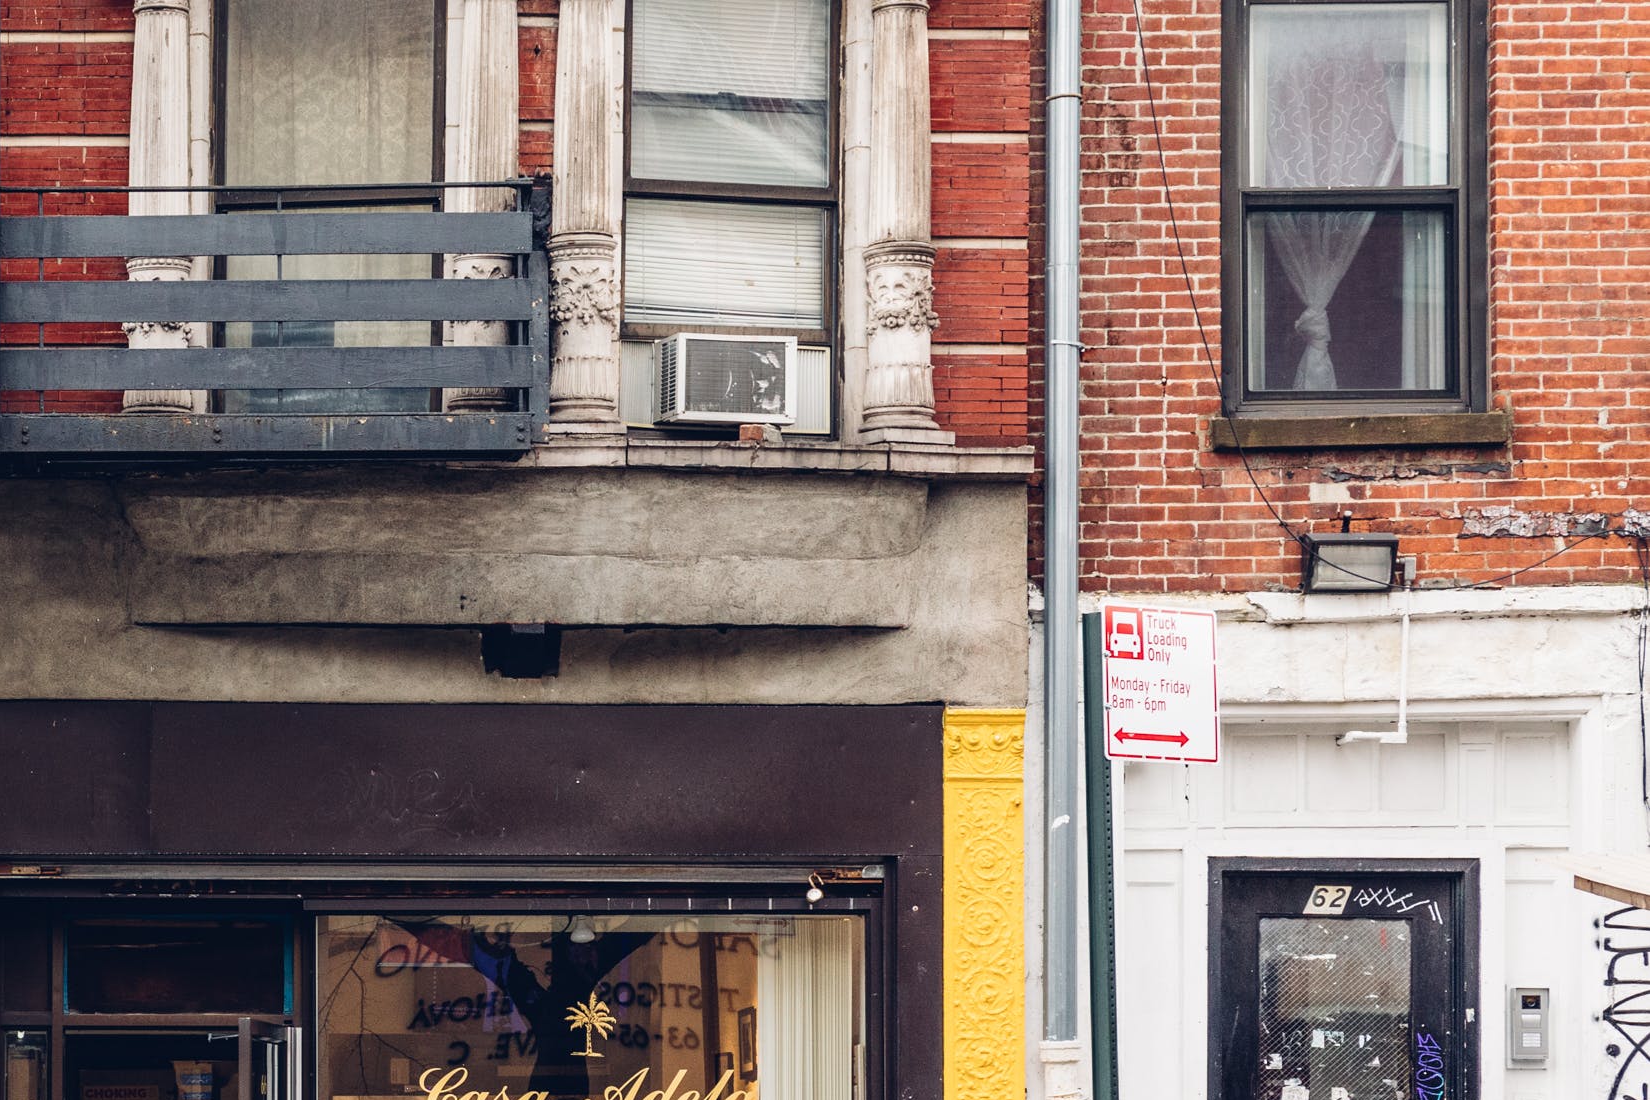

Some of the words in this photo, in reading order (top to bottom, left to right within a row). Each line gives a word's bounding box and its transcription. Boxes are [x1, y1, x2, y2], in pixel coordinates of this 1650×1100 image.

[1147, 614, 1176, 630] Truck
[1147, 631, 1187, 650] Loading
[1148, 648, 1171, 665] Only
[1111, 675, 1150, 692] Monday
[1160, 679, 1191, 697] Friday
[1111, 695, 1134, 709] 8am
[1144, 697, 1167, 714] 6pm
[1312, 887, 1347, 908] 62
[85, 1087, 147, 1099] CHOKING
